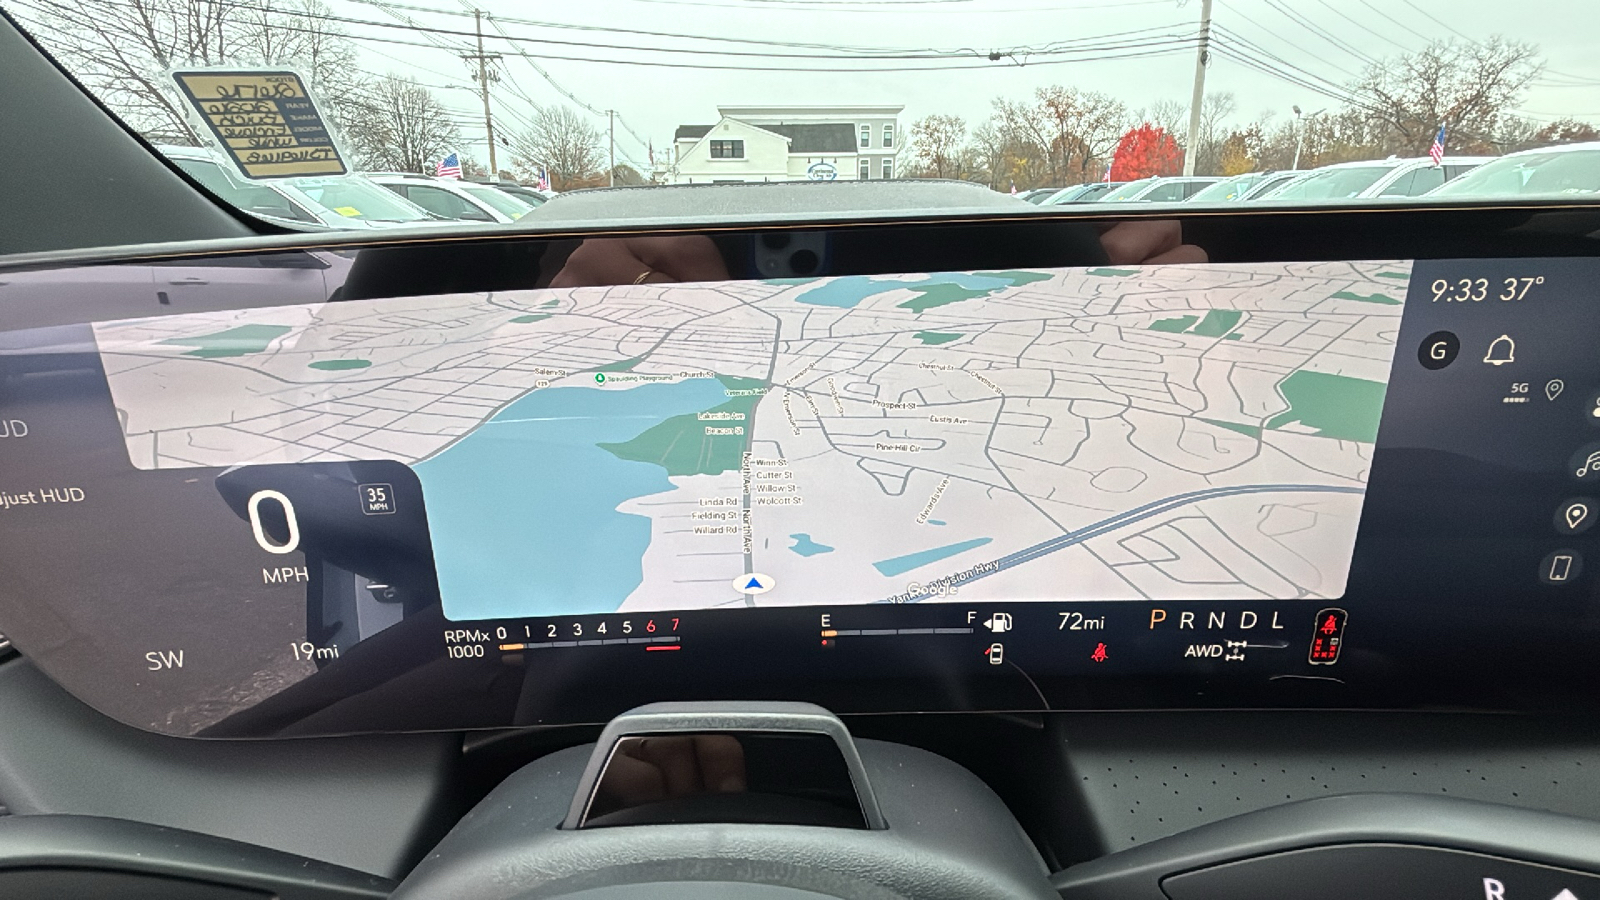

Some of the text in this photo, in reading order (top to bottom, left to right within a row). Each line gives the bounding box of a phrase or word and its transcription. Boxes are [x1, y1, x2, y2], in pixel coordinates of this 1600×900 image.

[1431, 276, 1545, 302] 9:33 37°
[1430, 341, 1447, 360] G
[535, 367, 557, 375] Salem
[919, 362, 946, 371] Chestnut
[608, 374, 673, 383] Spaulding Playground
[970, 371, 996, 390] Chestnut
[1511, 383, 1529, 393] 5G
[873, 400, 906, 409] Prospect
[698, 412, 745, 420] Lakeside Ave
[930, 415, 952, 424] Eustis
[706, 427, 744, 435] Beacon St
[876, 443, 893, 451] Pine
[743, 452, 751, 494] North Ave
[367, 487, 386, 502] 35
[756, 484, 796, 492] Willow St
[0, 487, 85, 509] just HUD
[757, 497, 802, 505] Wolcott St
[916, 480, 949, 524] Edwards Ave
[369, 502, 389, 511] MPH
[247, 489, 300, 554] 0
[692, 511, 737, 520] Fielding St
[694, 526, 738, 534] Willard Rd
[743, 509, 751, 553] North Ave
[262, 567, 309, 583] MPH
[974, 560, 1000, 575] Hwy
[907, 582, 958, 598] Google
[821, 614, 831, 627] E
[967, 611, 977, 624] F
[1058, 612, 1105, 630] 72mi
[1149, 609, 1284, 630] P R N D L
[444, 629, 491, 644] RPMx
[496, 618, 680, 640] 0 1 2 3 4 5 6 7
[291, 642, 339, 662] 19mi
[447, 644, 485, 659] 1000
[1184, 644, 1223, 658] AWD
[146, 650, 185, 671] SW
[1482, 877, 1505, 900] R
